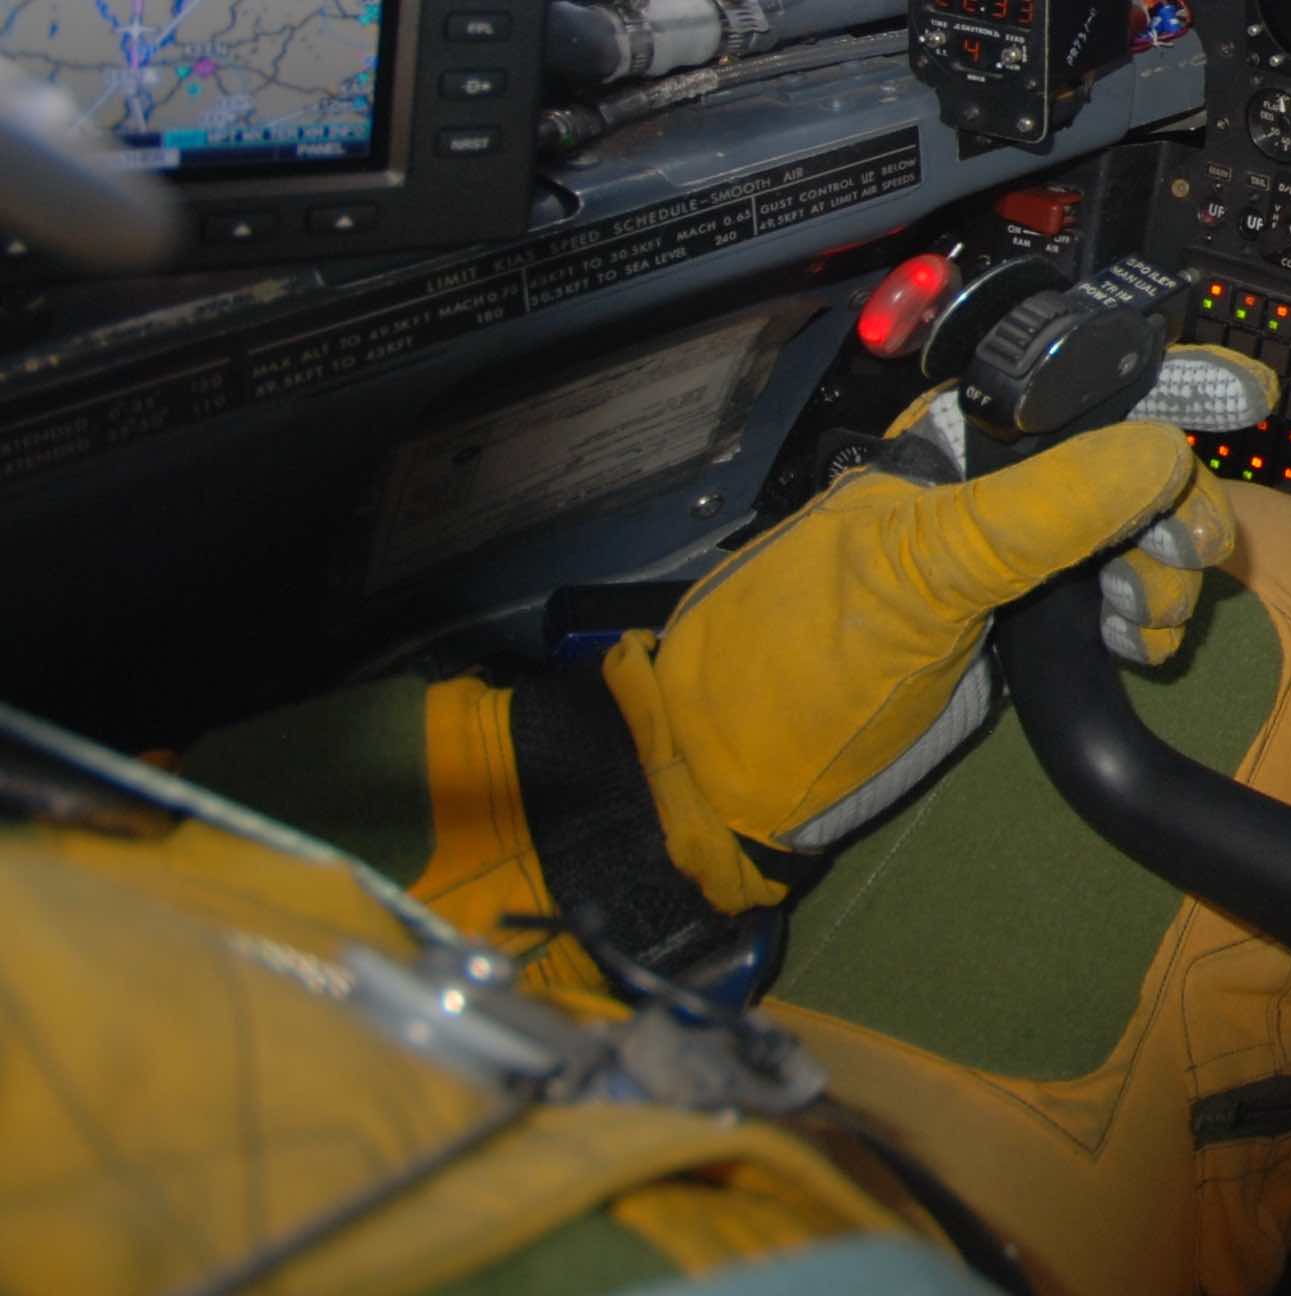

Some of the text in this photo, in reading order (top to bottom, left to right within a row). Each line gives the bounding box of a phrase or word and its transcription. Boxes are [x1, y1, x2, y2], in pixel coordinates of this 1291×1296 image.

[962, 36, 982, 65] 4
[759, 198, 794, 217] GUST
[798, 179, 856, 208] CONTROL
[880, 158, 918, 180] BELOW
[809, 171, 917, 218] AT LIMIT AIR SPEEDS
[425, 166, 805, 294] LIMIT KIAS SPEED AIR
[582, 255, 602, 272] TO
[676, 219, 718, 242] MACH
[595, 268, 618, 286] TO
[624, 257, 650, 277] SEA
[652, 246, 688, 269] LEVEL
[1110, 264, 1160, 298] MANUAL
[1124, 256, 1178, 290] SPOILER
[438, 292, 486, 317] MACH
[1100, 279, 1136, 303] TRIM
[965, 386, 992, 407] OFF
